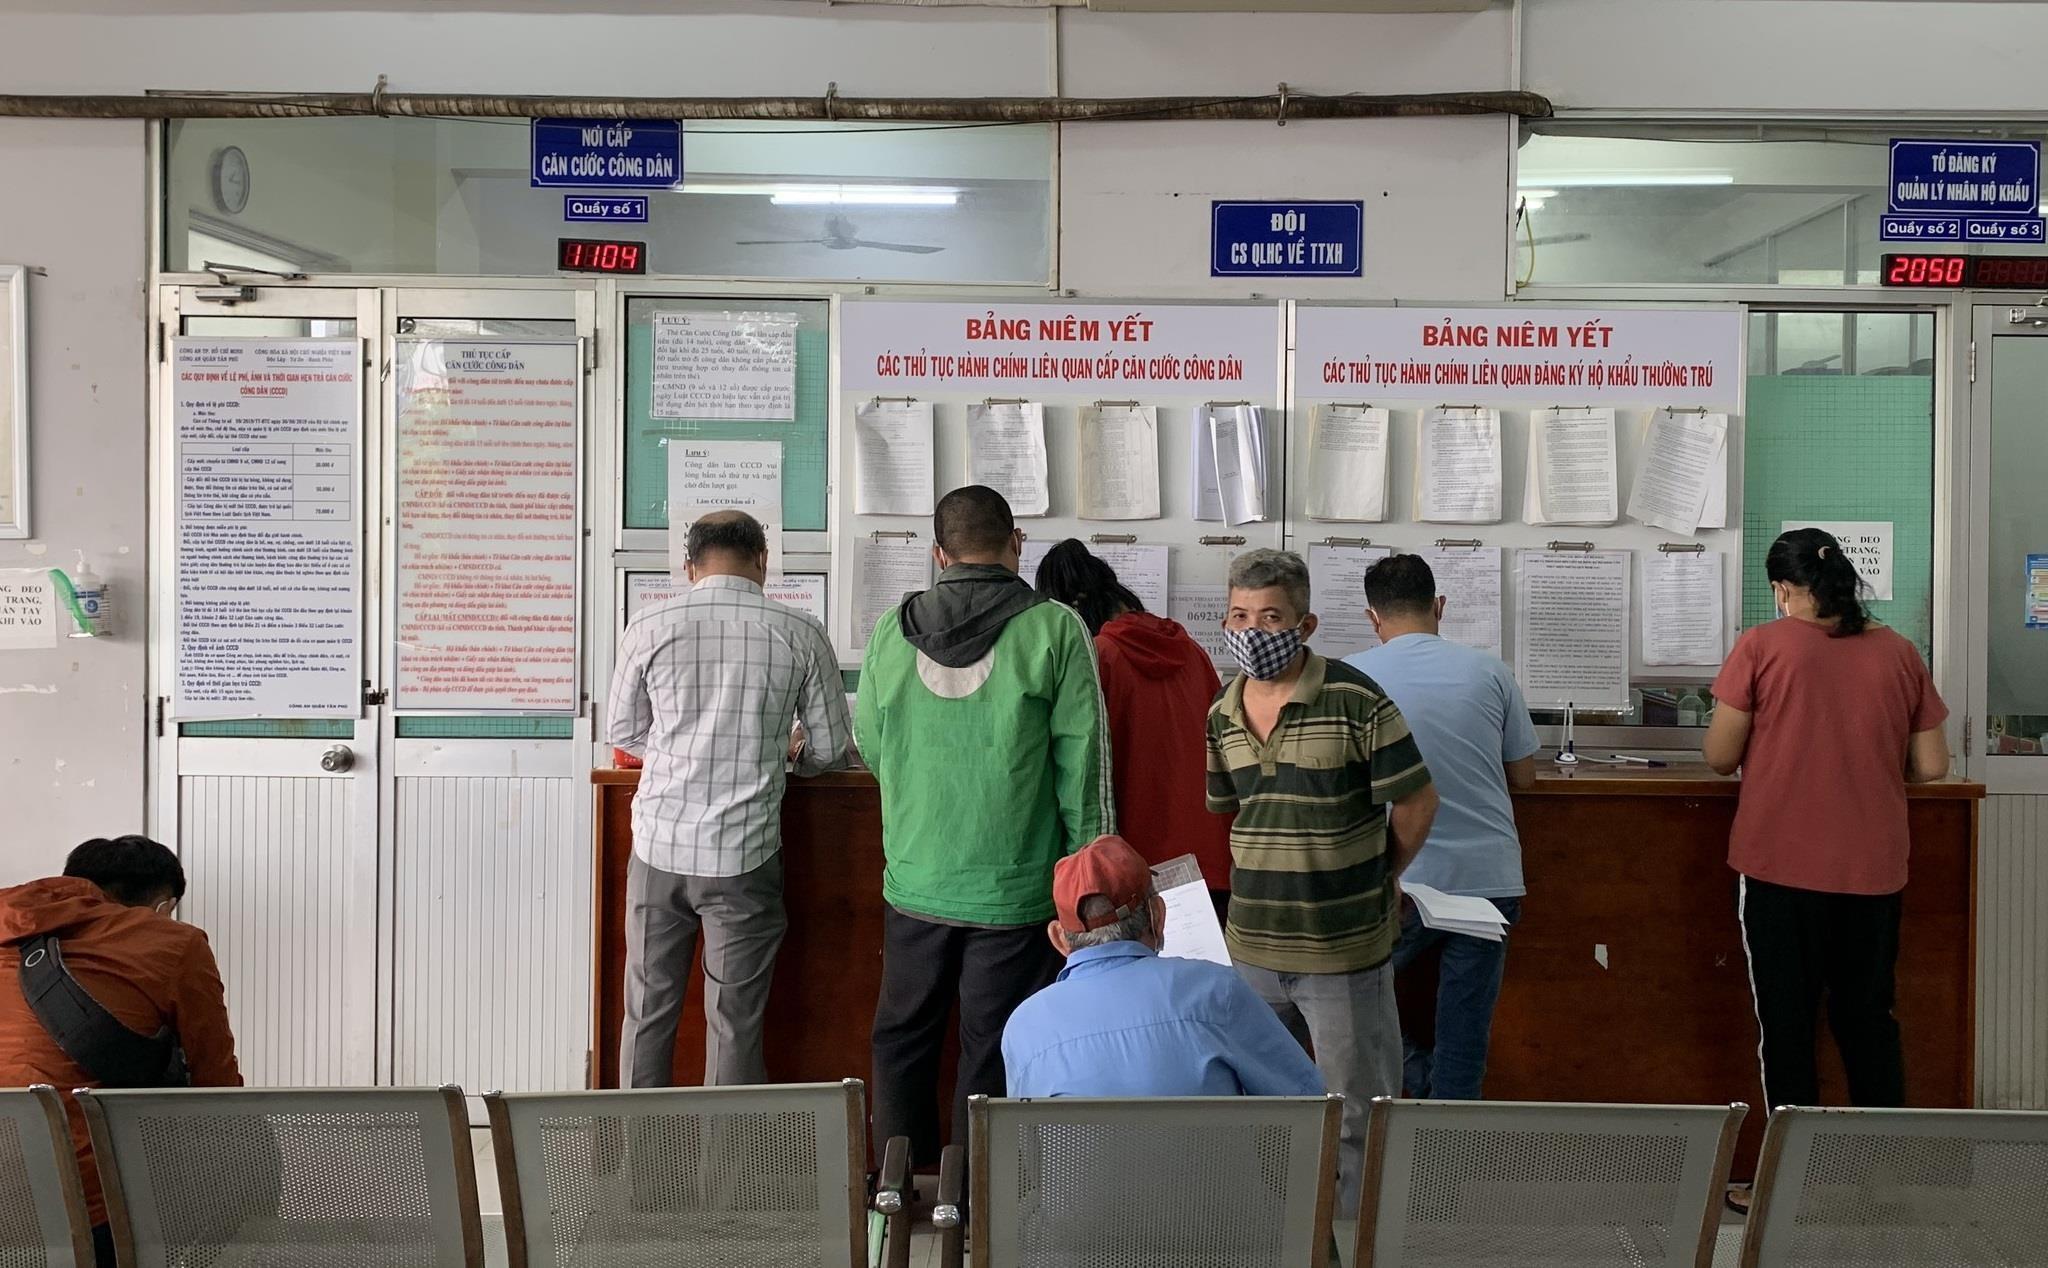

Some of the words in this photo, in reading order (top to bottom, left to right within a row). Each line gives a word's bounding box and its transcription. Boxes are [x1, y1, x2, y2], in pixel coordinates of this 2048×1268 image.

[606, 120, 633, 148] CẤP
[541, 152, 568, 176] CĂN
[571, 151, 605, 177] CƯỚC
[608, 152, 643, 177] CÔNG
[646, 152, 673, 178] DÂN
[1931, 148, 1947, 173] TỔ
[1948, 151, 1980, 174] ĐĂNG
[1981, 151, 1997, 174] KÝ
[1897, 175, 1929, 202] QUẢN
[1930, 179, 1945, 201] LÝ
[1946, 179, 1980, 201] NHÂN
[1981, 180, 1997, 205] HỘ
[1999, 177, 2030, 202] KHẨU
[613, 202, 632, 215] số
[635, 203, 642, 215] 1
[1270, 209, 1306, 236] ĐỘI
[1927, 221, 1946, 235] số
[1948, 223, 1957, 234] 2
[2010, 223, 2029, 236] số
[2031, 224, 2040, 236] 3
[573, 244, 638, 269] 1104
[1231, 242, 1248, 265] CS
[1252, 242, 1283, 268] QLHC
[1310, 242, 1343, 265] TTXH
[1890, 257, 1964, 283] 2050
[966, 310, 1031, 341] BẢNG
[1039, 313, 1099, 341] NIÊM
[1107, 312, 1154, 342] YẾT
[1423, 316, 1488, 347] BẢNG
[1497, 320, 1557, 347] NIÊM
[1567, 318, 1614, 348] YẾT
[877, 349, 900, 377] CÁC
[904, 347, 927, 377] THỦ
[931, 355, 954, 382] TỤC
[957, 350, 989, 378] HÀNH
[993, 351, 1028, 379] CHÍNH
[1032, 352, 1058, 379] LIÊN
[1062, 358, 1092, 382] QUAN
[1096, 350, 1119, 380] CẤP
[1122, 353, 1146, 380] CĂN
[1149, 353, 1180, 380] CƯỚC
[1183, 353, 1215, 381] CÔNG
[1218, 353, 1242, 381] DÂN
[1323, 355, 1346, 384] CÁC
[1348, 353, 1371, 384] THỦ
[1375, 362, 1397, 389] TỤC
[1400, 357, 1431, 385] HÀNH
[1435, 358, 1468, 385] CHÍNH
[1472, 358, 1498, 385] LIÊN
[1501, 363, 1531, 389] QUAN
[1534, 359, 1565, 386] ĐĂNG
[1569, 359, 1584, 386] KÝ
[1588, 359, 1604, 390] HỘ
[1607, 354, 1639, 386] KHẨU
[1641, 360, 1688, 387] THƯỜNG
[1690, 360, 1713, 387] TRÚ
[685, 449, 701, 457] Lưu
[1845, 546, 1881, 555] TRANG,
[1861, 557, 1881, 565] TAY
[6, 596, 42, 605] TRANG,
[21, 607, 41, 615] TAY
[1187, 611, 1228, 621] 069234
